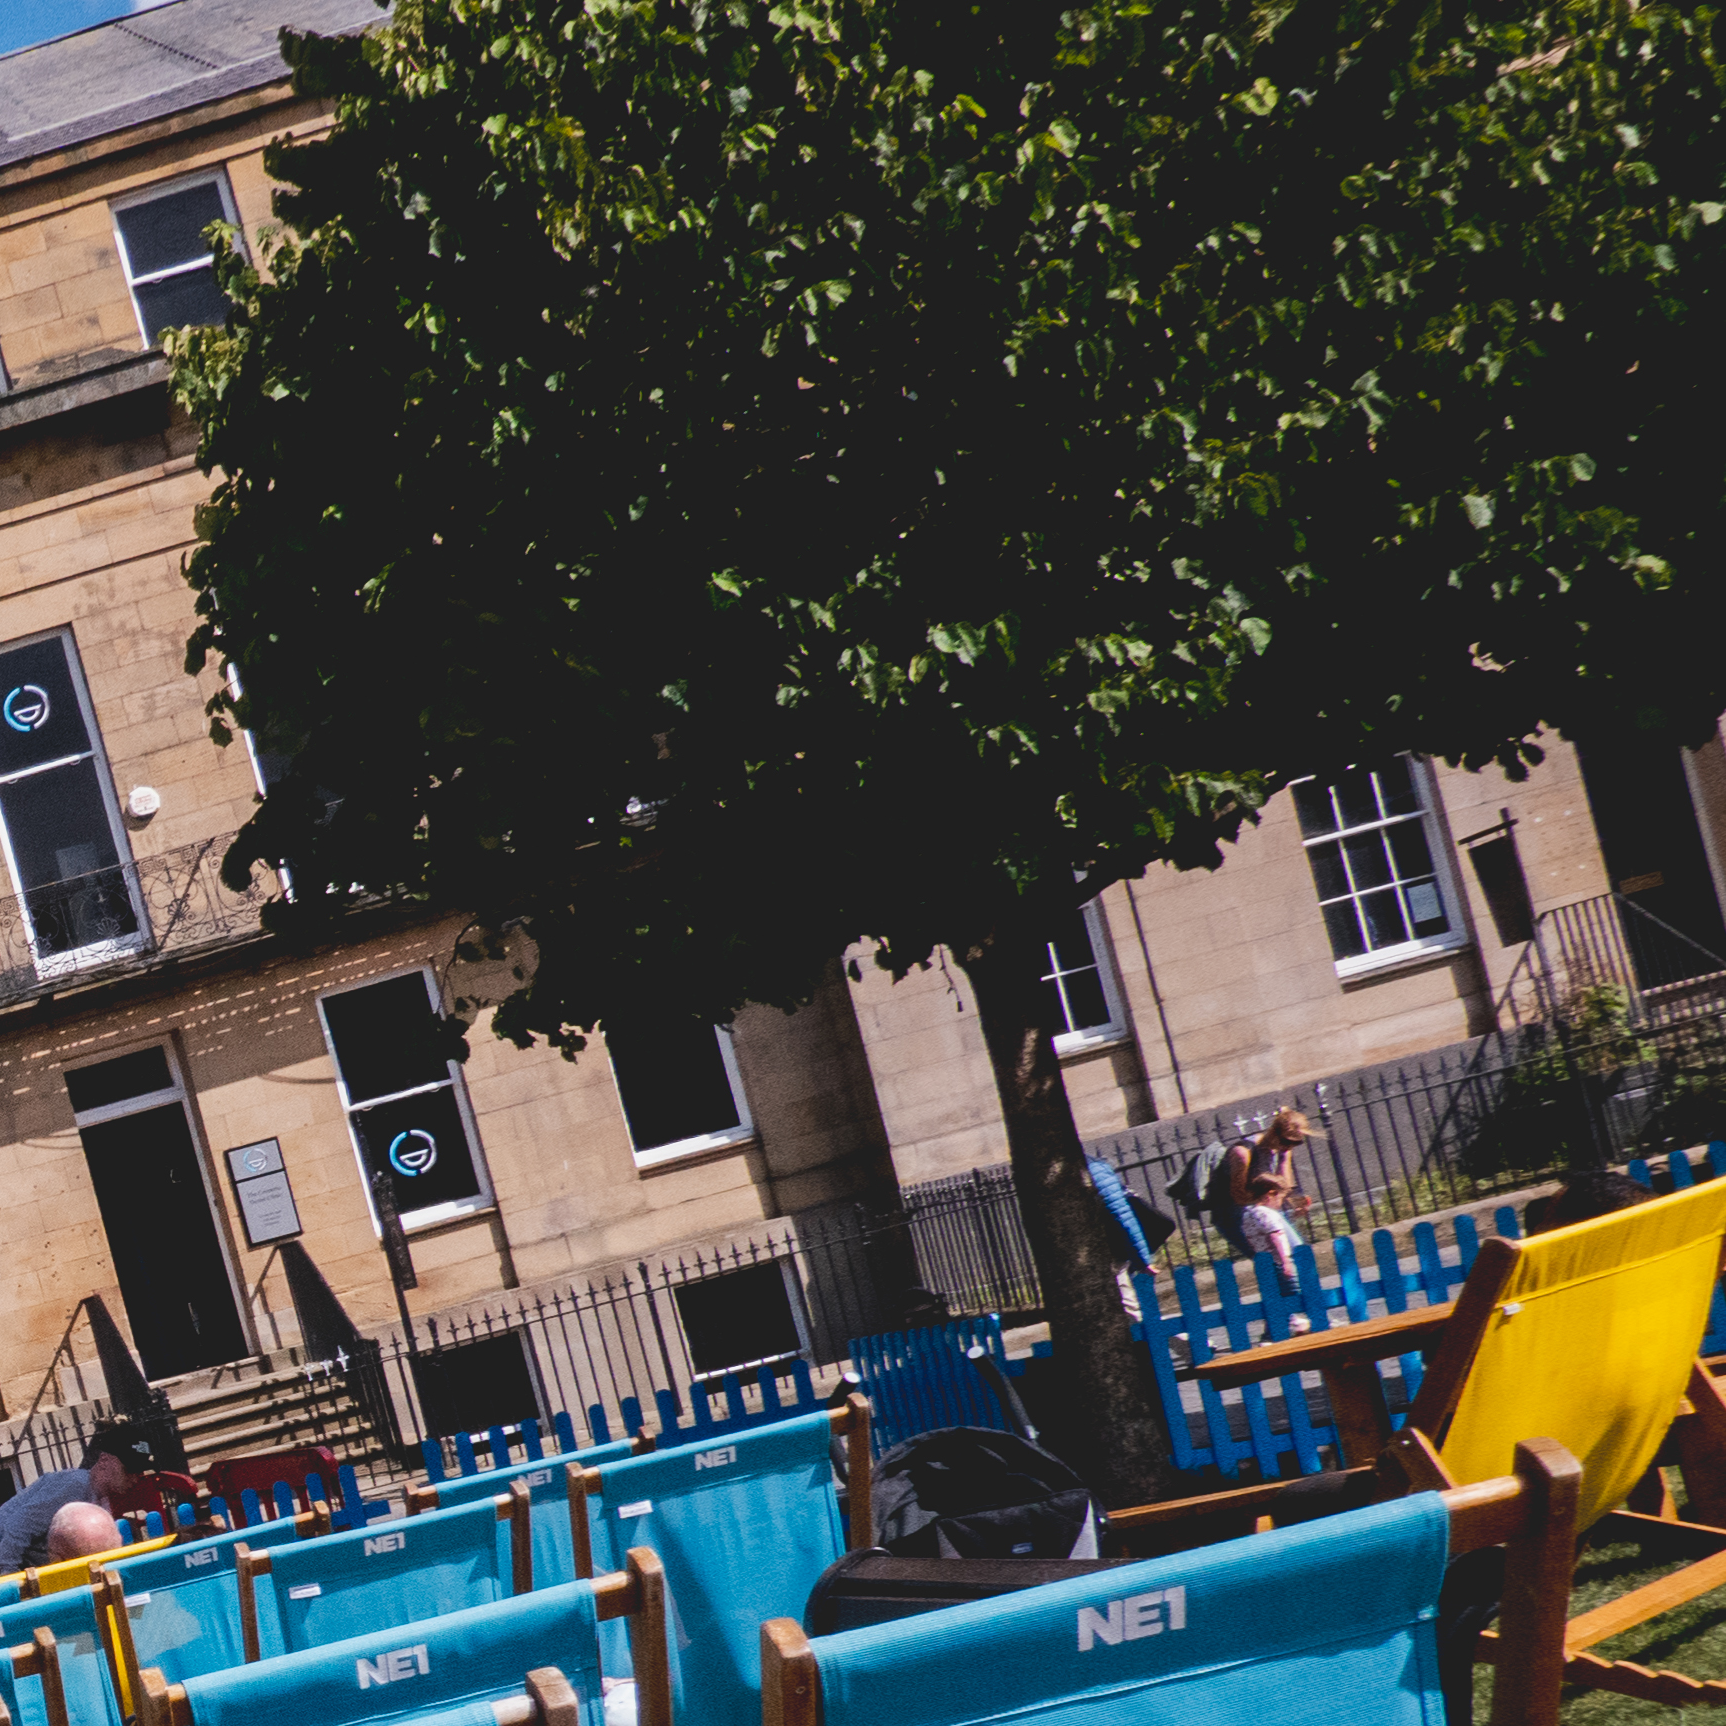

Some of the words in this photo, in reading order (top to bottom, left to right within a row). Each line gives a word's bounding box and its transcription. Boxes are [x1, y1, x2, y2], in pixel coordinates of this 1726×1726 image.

[695, 1446, 736, 1470] NE1
[517, 1469, 552, 1486] NE1
[364, 1532, 405, 1556] NE1
[185, 1547, 218, 1568] NE1
[1077, 1586, 1185, 1651] NE1
[356, 1644, 429, 1689] NE1
